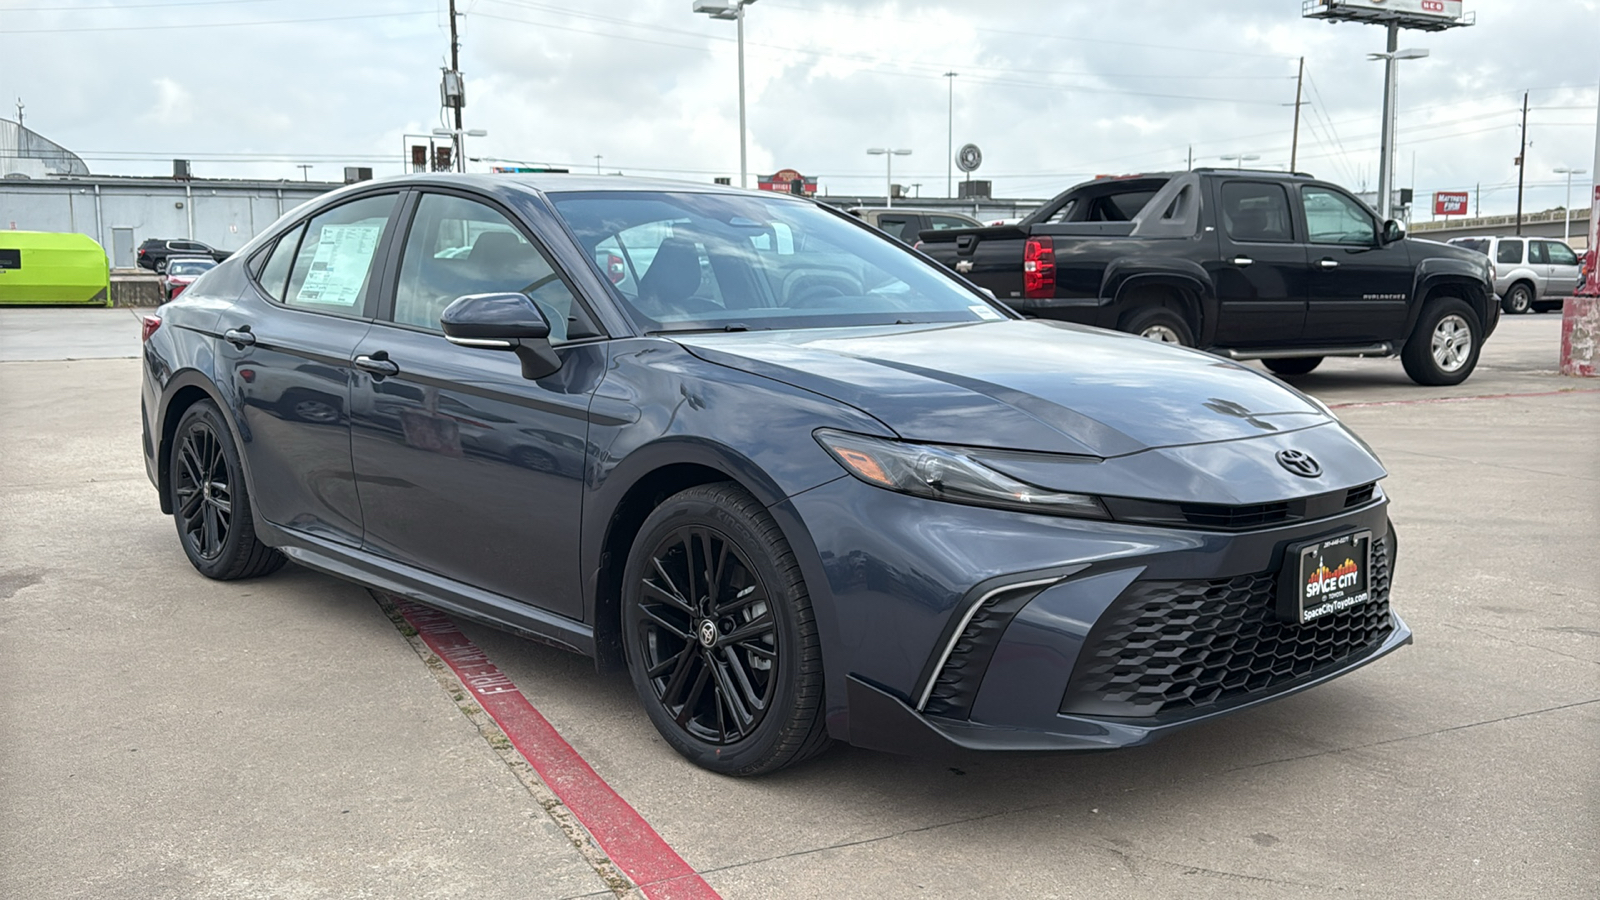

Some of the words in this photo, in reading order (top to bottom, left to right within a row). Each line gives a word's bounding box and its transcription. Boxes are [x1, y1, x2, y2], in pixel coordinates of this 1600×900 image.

[1306, 577, 1336, 597] SPACE
[1338, 571, 1358, 588] CITY
[1328, 591, 1344, 599] TOYOTA
[1304, 592, 1368, 620] SpaceCityToyota.com
[464, 669, 519, 695] FIRE
